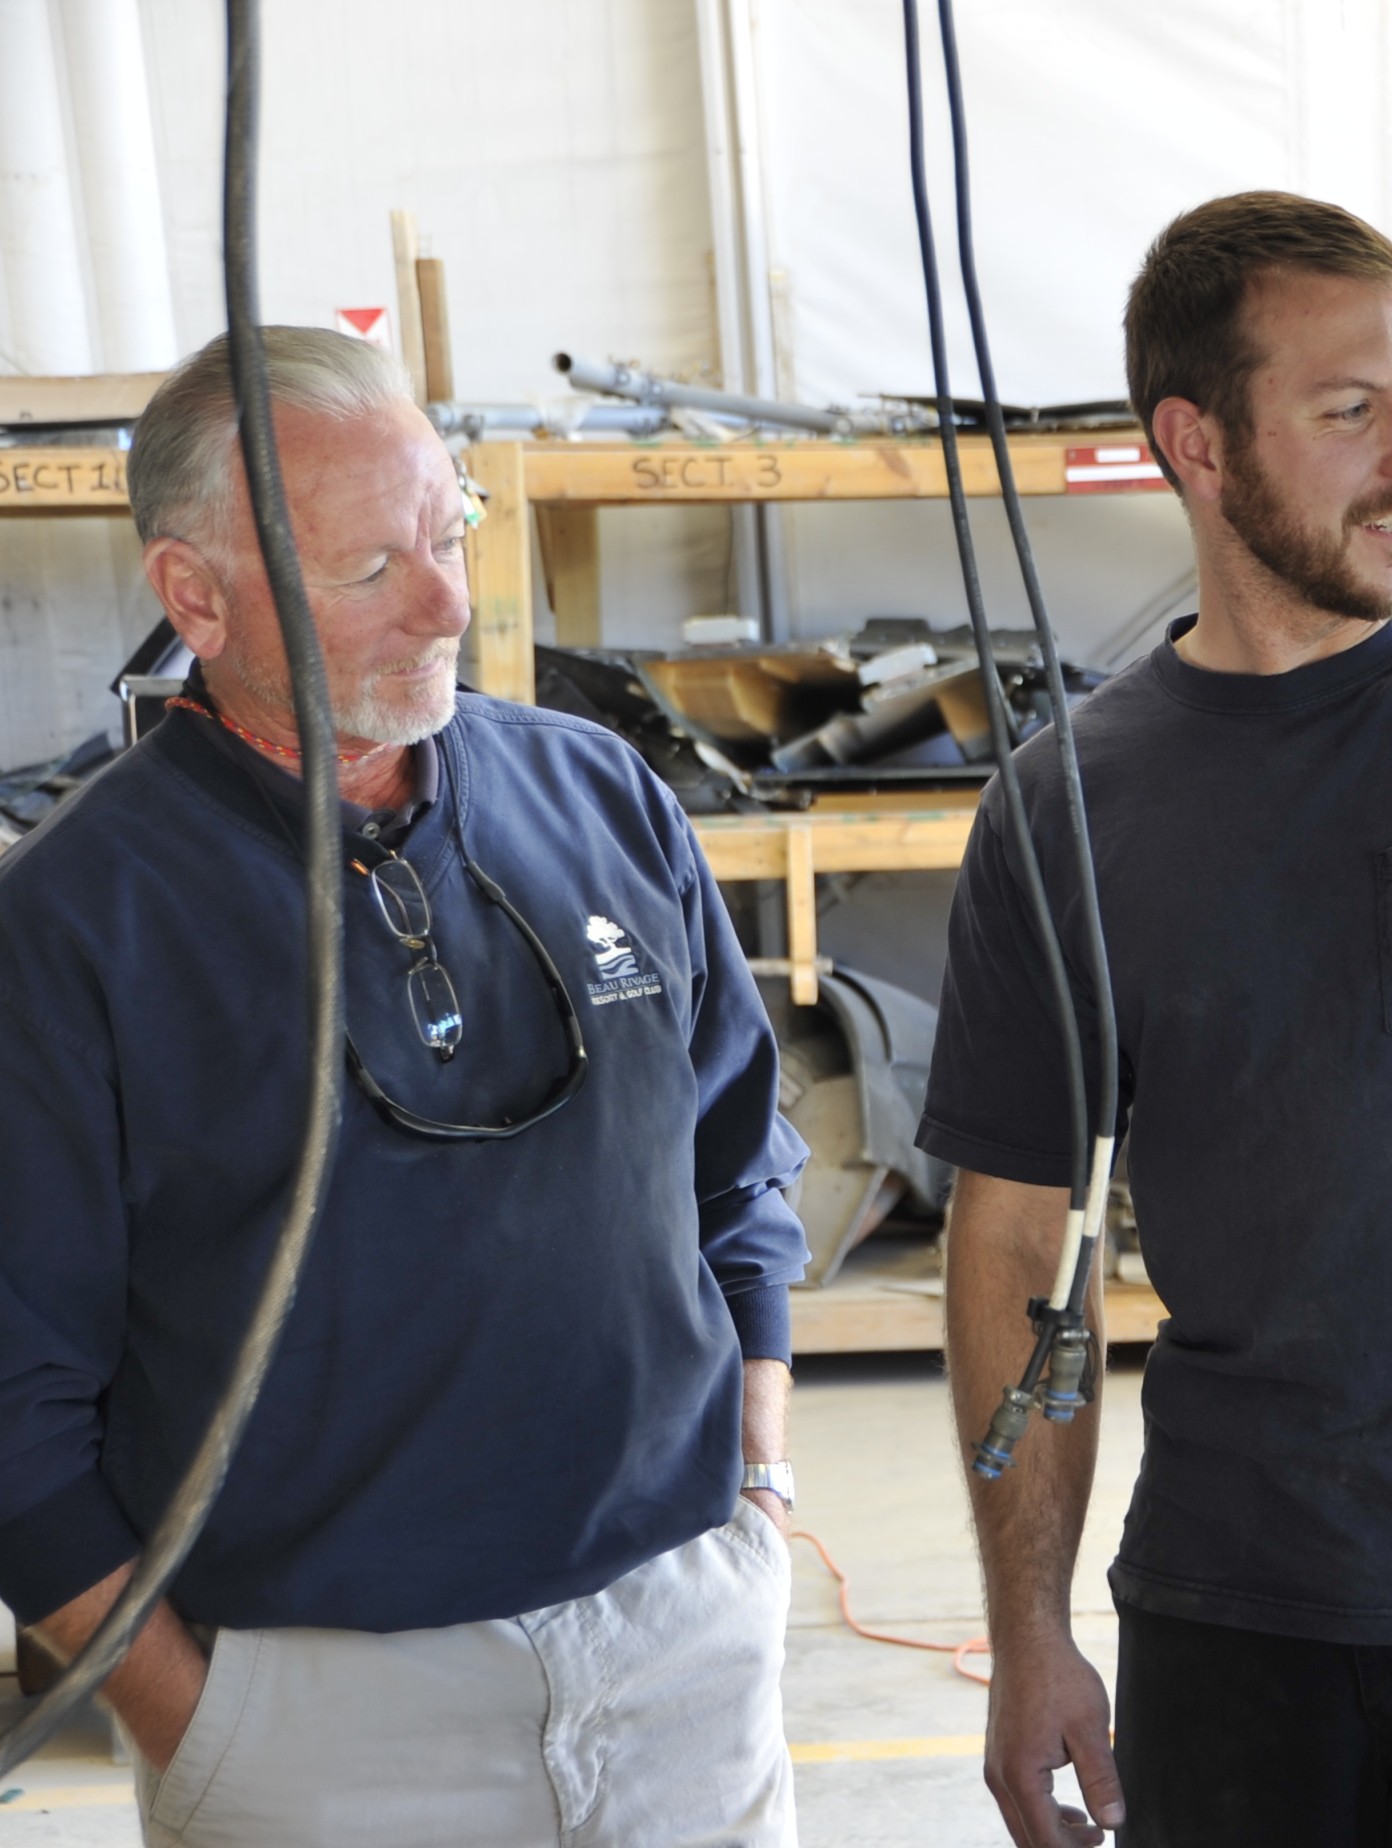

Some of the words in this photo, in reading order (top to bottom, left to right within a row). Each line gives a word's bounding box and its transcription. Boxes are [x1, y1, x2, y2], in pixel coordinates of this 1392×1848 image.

[755, 454, 783, 488] 3
[586, 981, 619, 995] BEAU
[620, 973, 660, 988] RIVAGE
